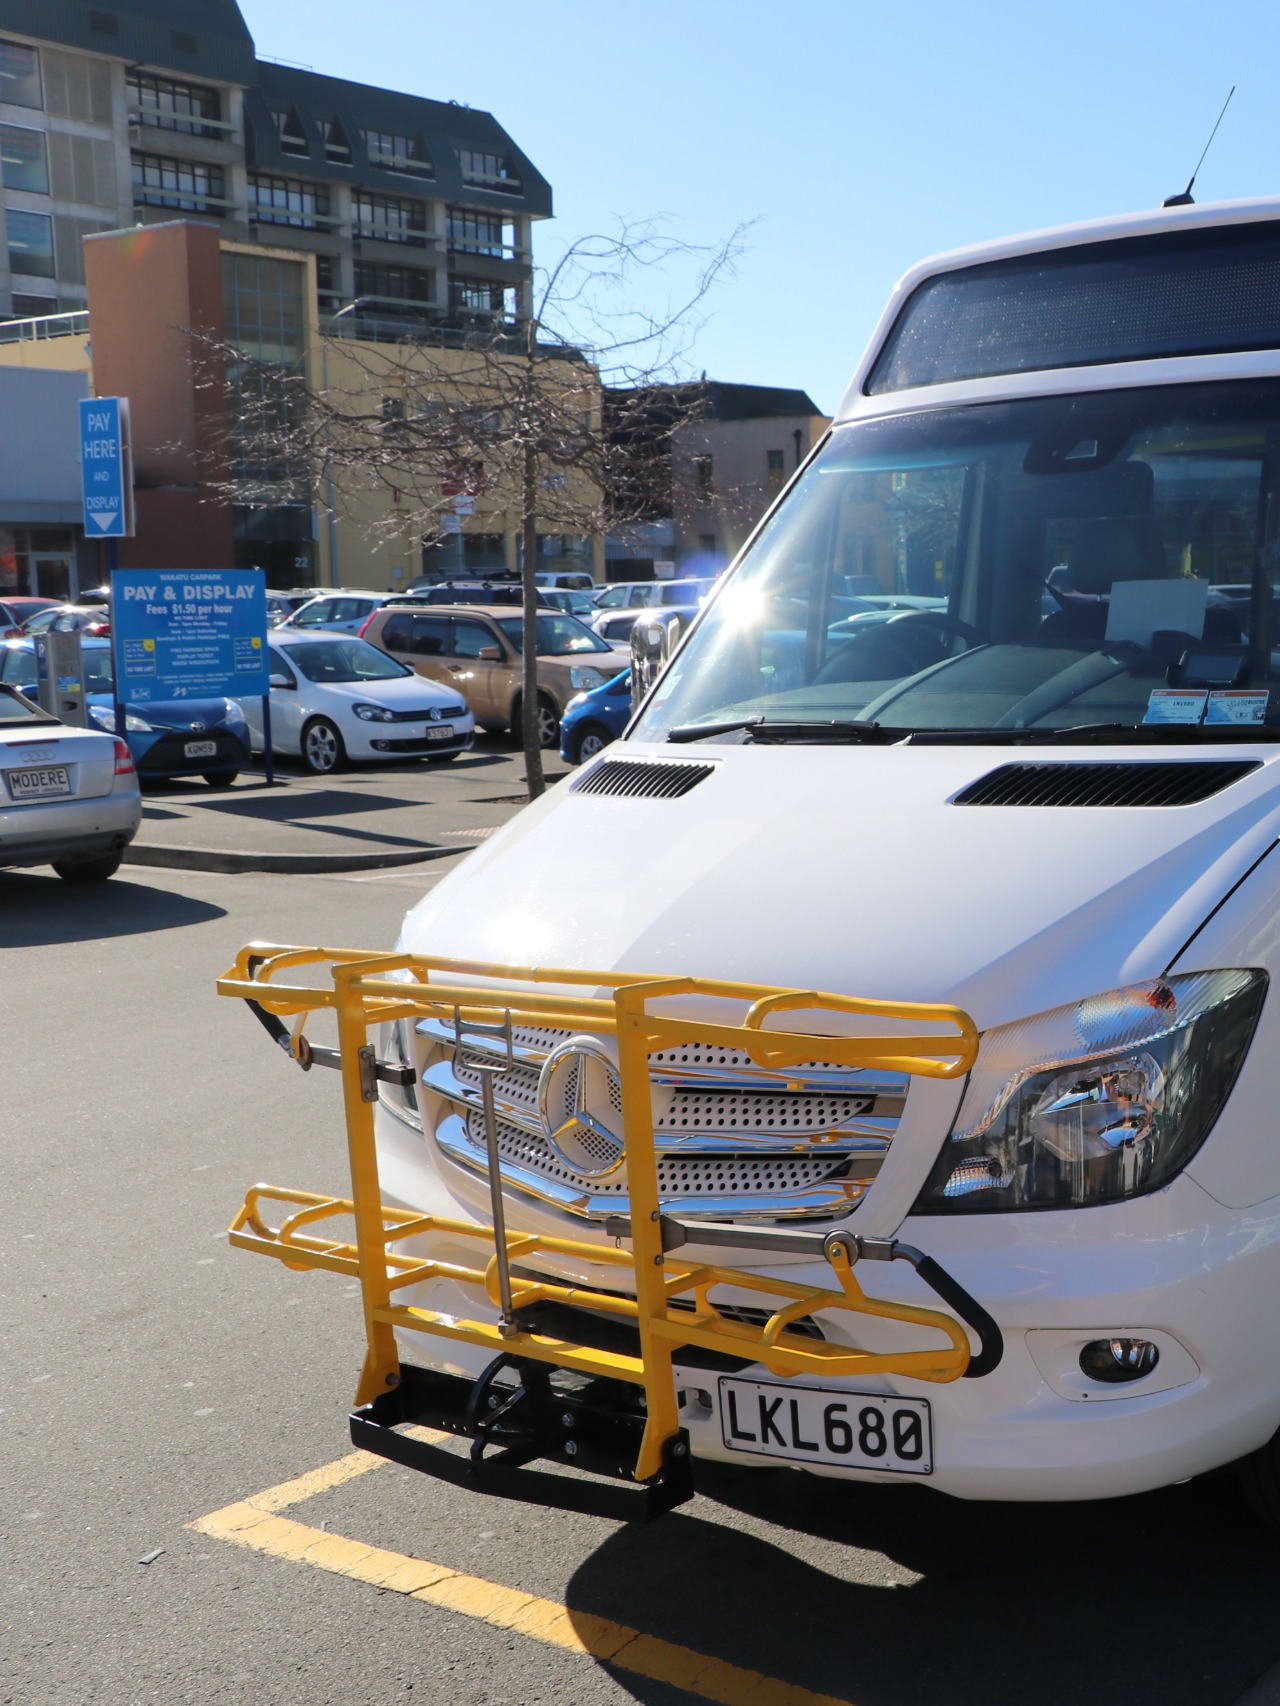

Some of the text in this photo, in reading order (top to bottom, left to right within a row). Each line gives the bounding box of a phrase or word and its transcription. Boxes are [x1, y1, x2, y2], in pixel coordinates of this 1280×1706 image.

[88, 412, 111, 432] PAY
[84, 439, 116, 459] HERE
[94, 471, 110, 482] AND
[86, 496, 119, 509] DISPLAY
[295, 557, 307, 567] 22
[124, 585, 255, 600] PAY & DISPLAY
[146, 604, 233, 616] Fees $1.50 per hour
[11, 770, 66, 788] MODERE
[728, 1390, 923, 1460] LKL680
